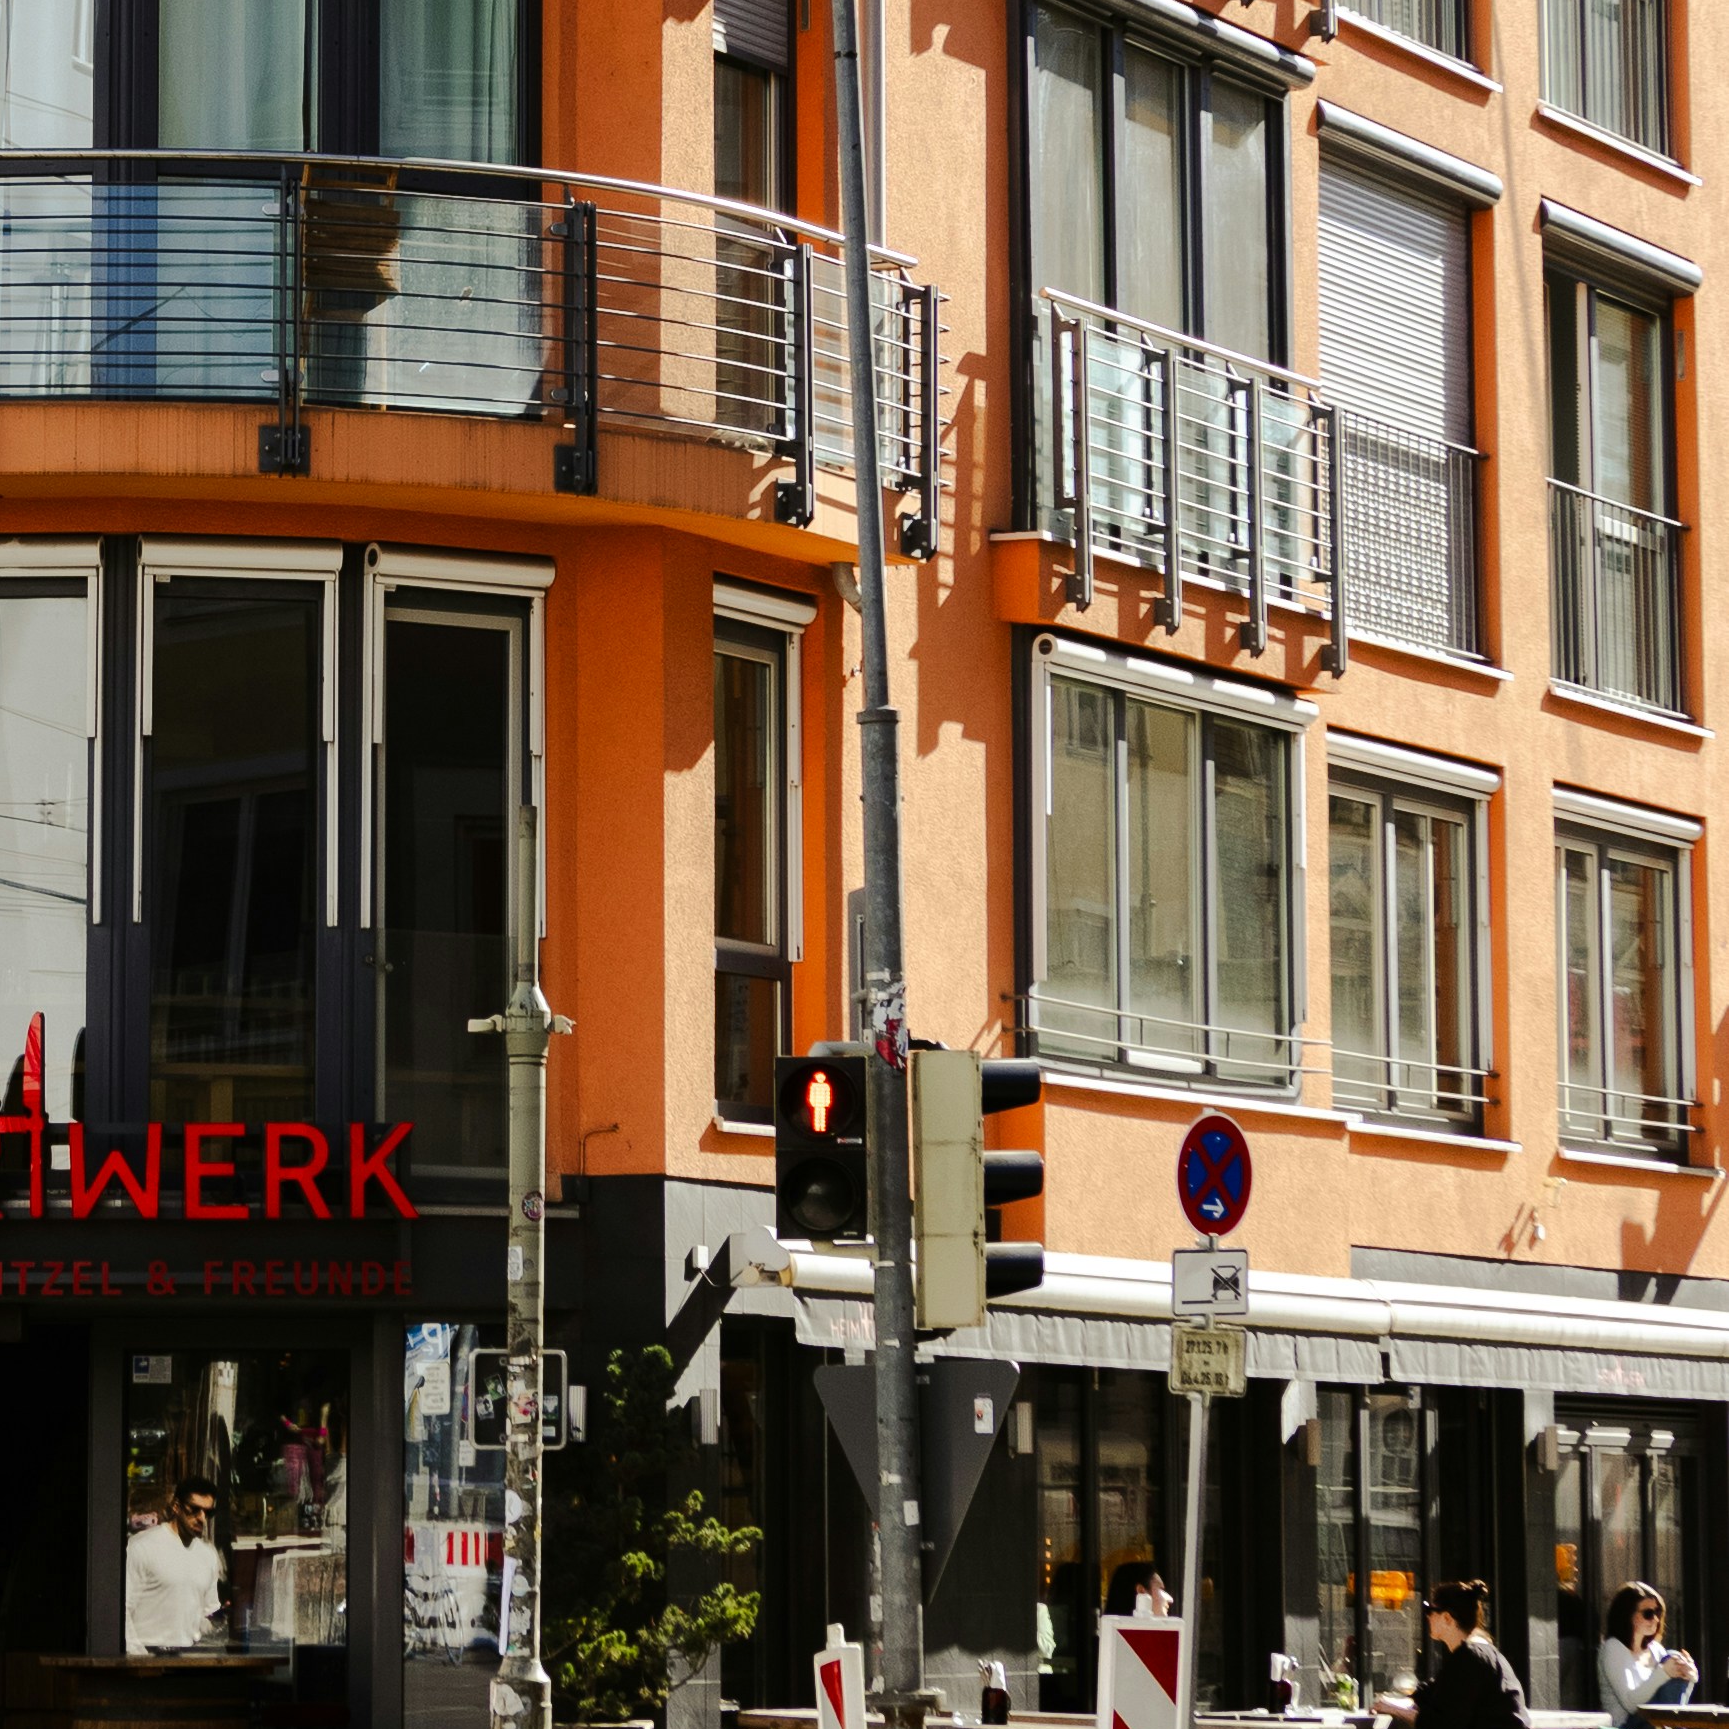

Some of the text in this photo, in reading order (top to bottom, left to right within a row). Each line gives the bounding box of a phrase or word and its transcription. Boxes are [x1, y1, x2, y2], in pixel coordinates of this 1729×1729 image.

[70, 1121, 421, 1221] WERK
[146, 1259, 177, 1297] &
[202, 1259, 414, 1298] FREUNDE
